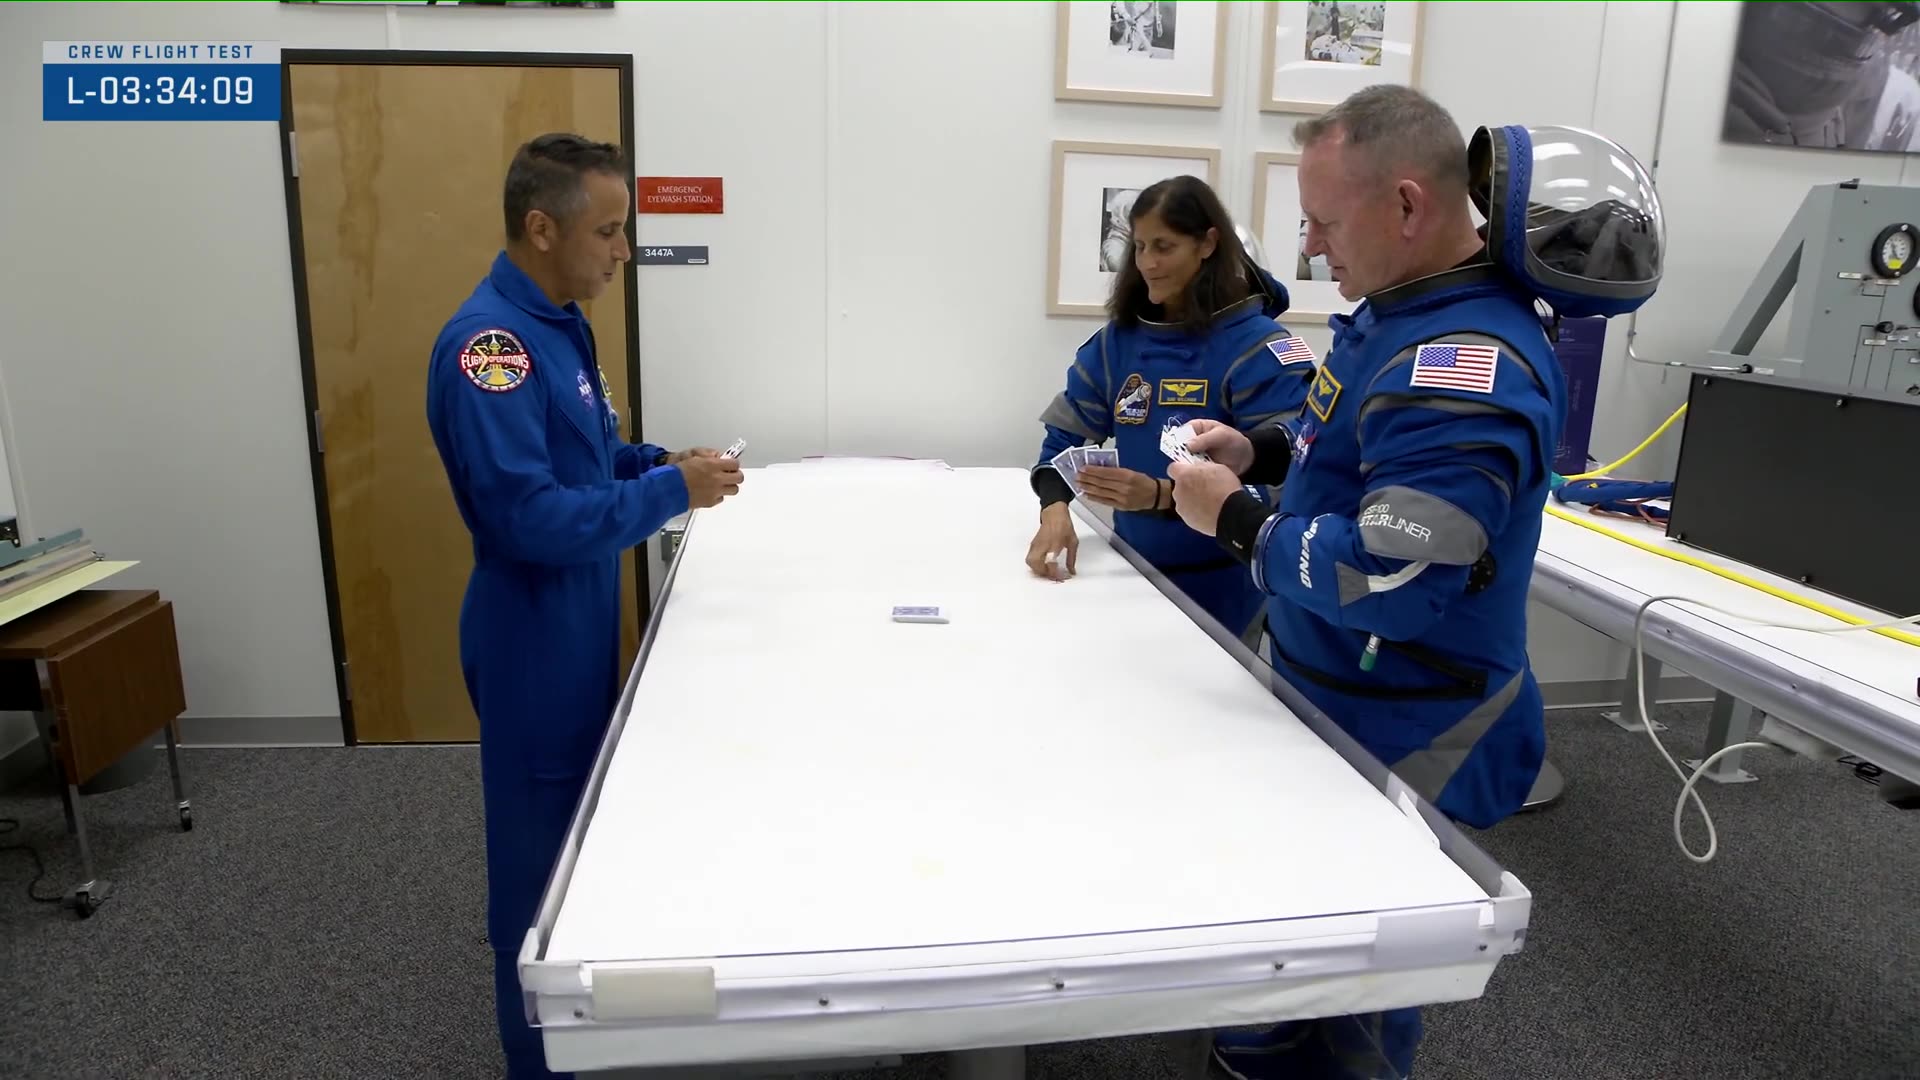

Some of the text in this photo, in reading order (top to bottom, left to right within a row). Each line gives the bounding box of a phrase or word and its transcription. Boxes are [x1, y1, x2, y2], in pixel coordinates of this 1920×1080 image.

[647, 195, 713, 203] EYEWASH STATION
[645, 248, 674, 257] 3447A
[488, 354, 529, 369] OPERATIONS
[1358, 514, 1432, 542] STARLINER
